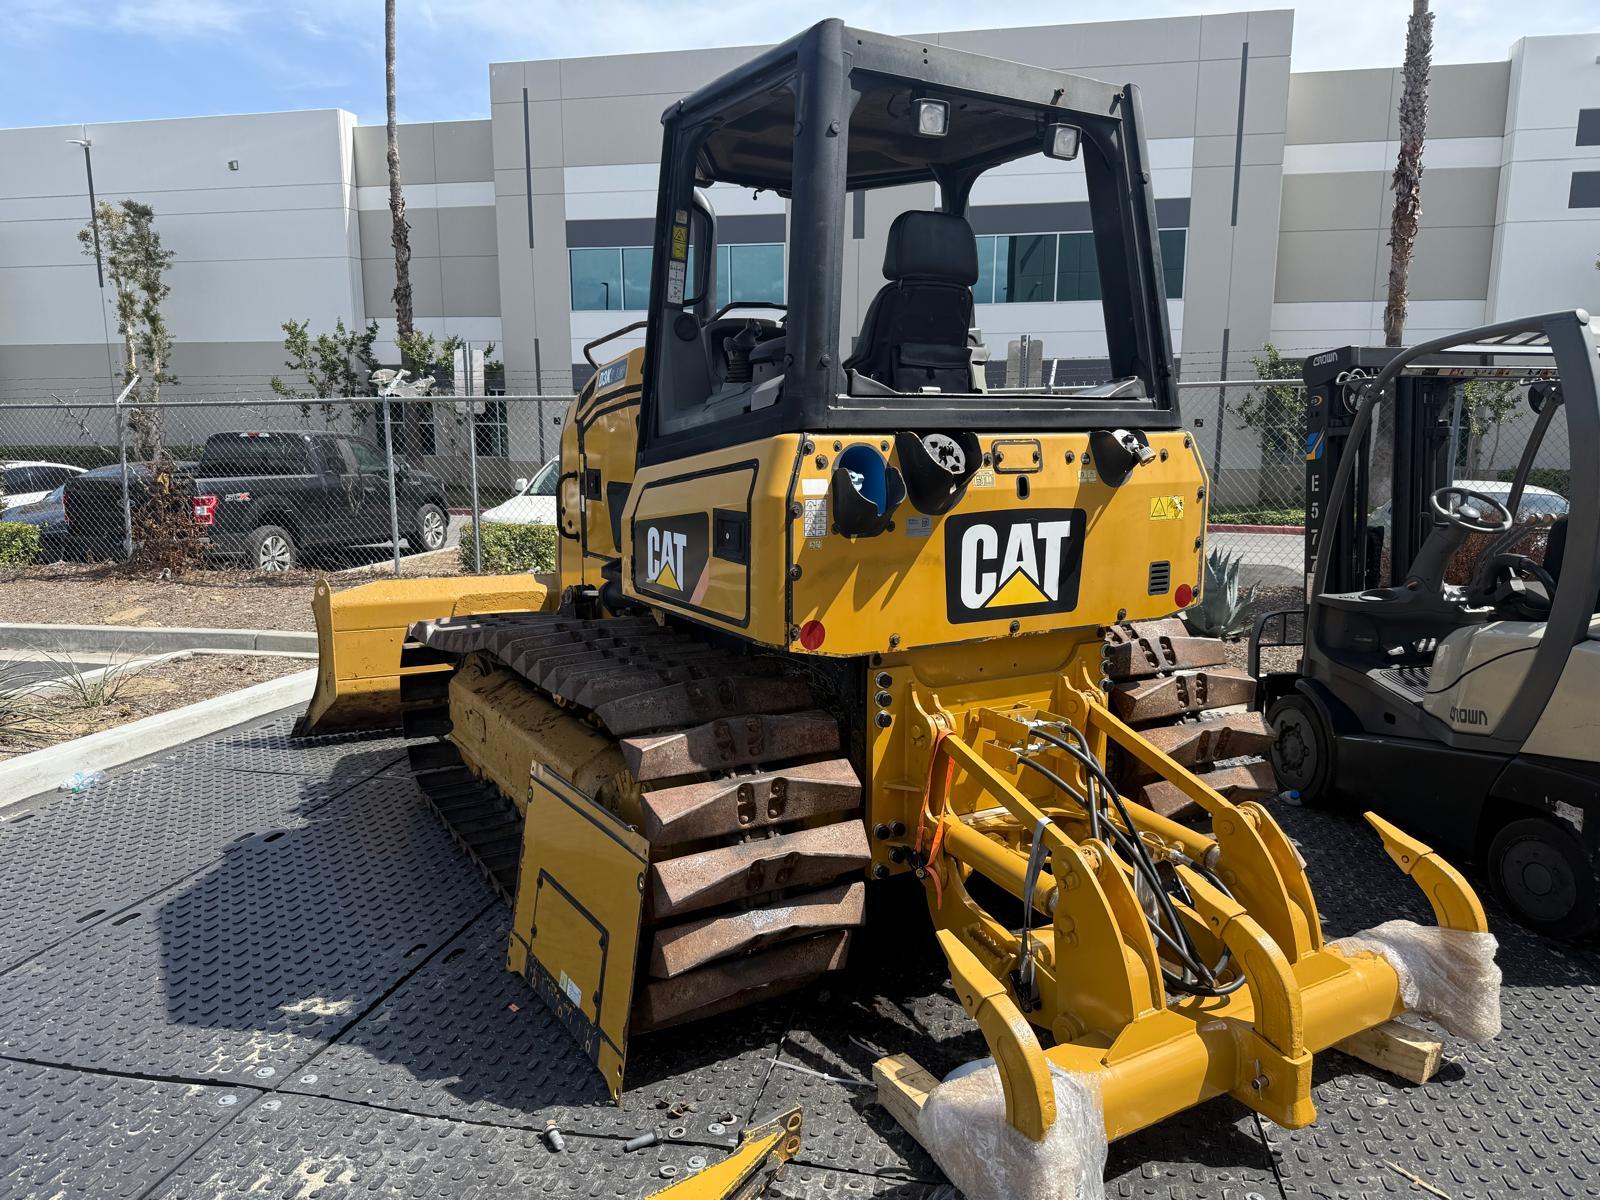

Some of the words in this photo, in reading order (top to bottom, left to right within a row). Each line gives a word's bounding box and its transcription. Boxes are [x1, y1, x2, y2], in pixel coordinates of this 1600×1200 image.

[1313, 352, 1338, 367] CROWN
[647, 526, 687, 592] CAT
[961, 521, 1070, 609] CAT
[1450, 705, 1488, 726] CROWN
